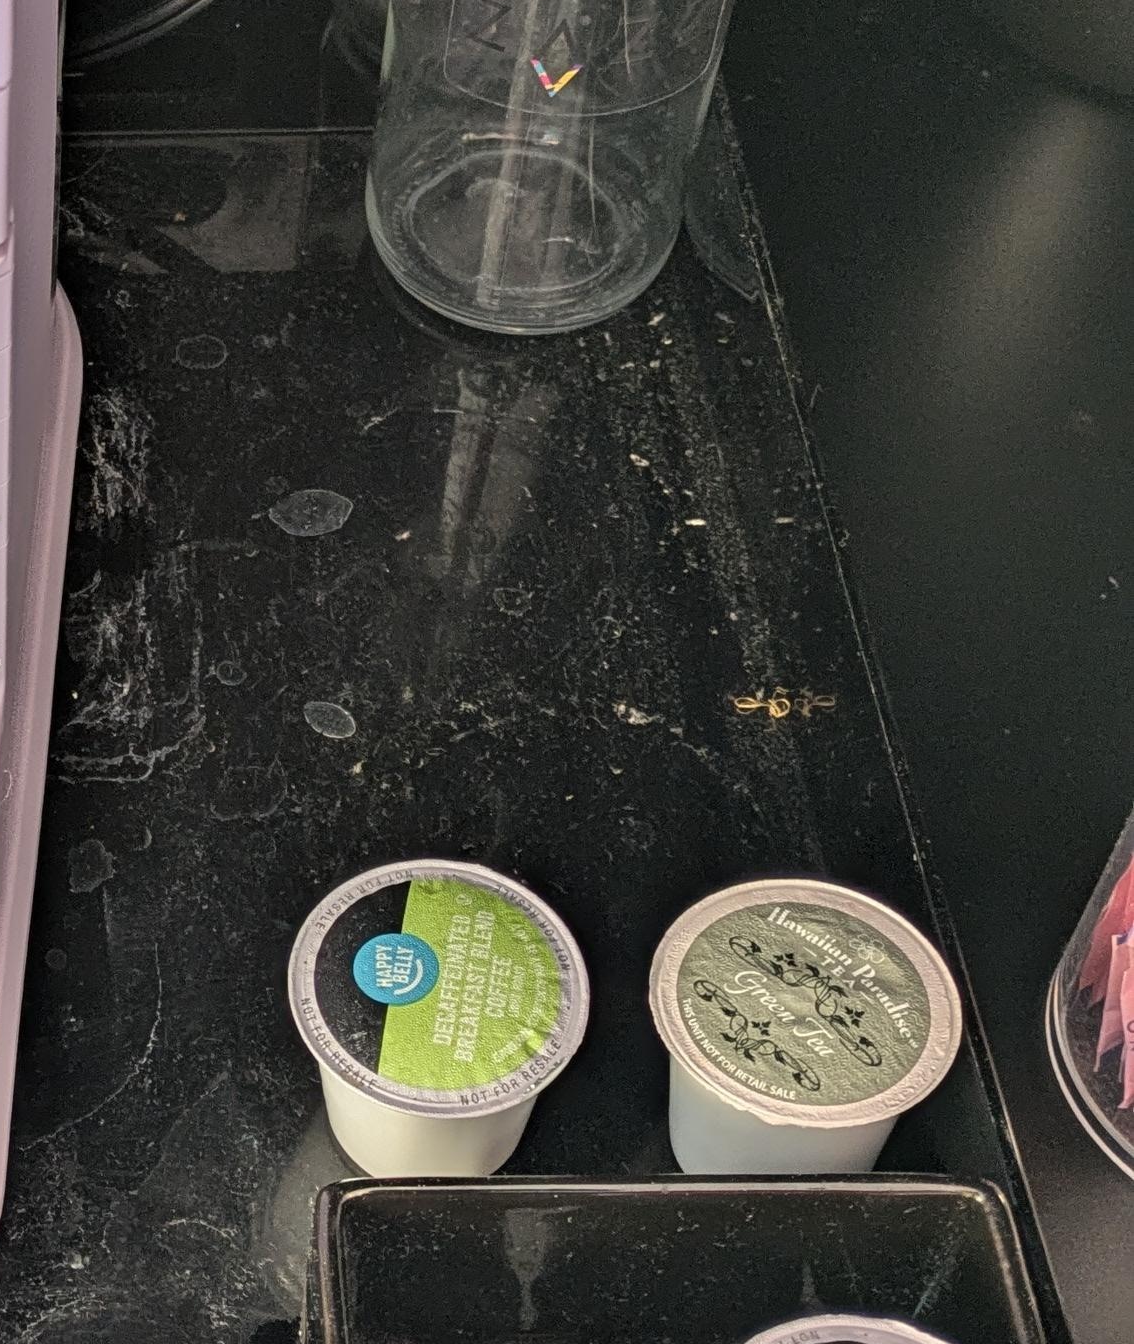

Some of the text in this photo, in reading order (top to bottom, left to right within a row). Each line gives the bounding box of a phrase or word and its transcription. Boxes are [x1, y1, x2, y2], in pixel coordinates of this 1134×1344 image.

[377, 944, 393, 988] HAPPY
[393, 946, 414, 985] BELLY
[767, 906, 852, 967] Hawaiian
[432, 915, 471, 1047] DECAFFEINATED
[486, 955, 513, 1019] COFFEE
[820, 958, 856, 989] TEA
[301, 997, 378, 1090] NOT FOR RESALE
[454, 961, 487, 1063] BREAKFAST
[724, 970, 835, 1057] Green Tea
[460, 1090, 487, 1106] NOT
[492, 1078, 521, 1097] FOR
[522, 1038, 562, 1084] RESALE
[682, 998, 796, 1100] THIS UNIT NOT FOR RETAIL SALE
